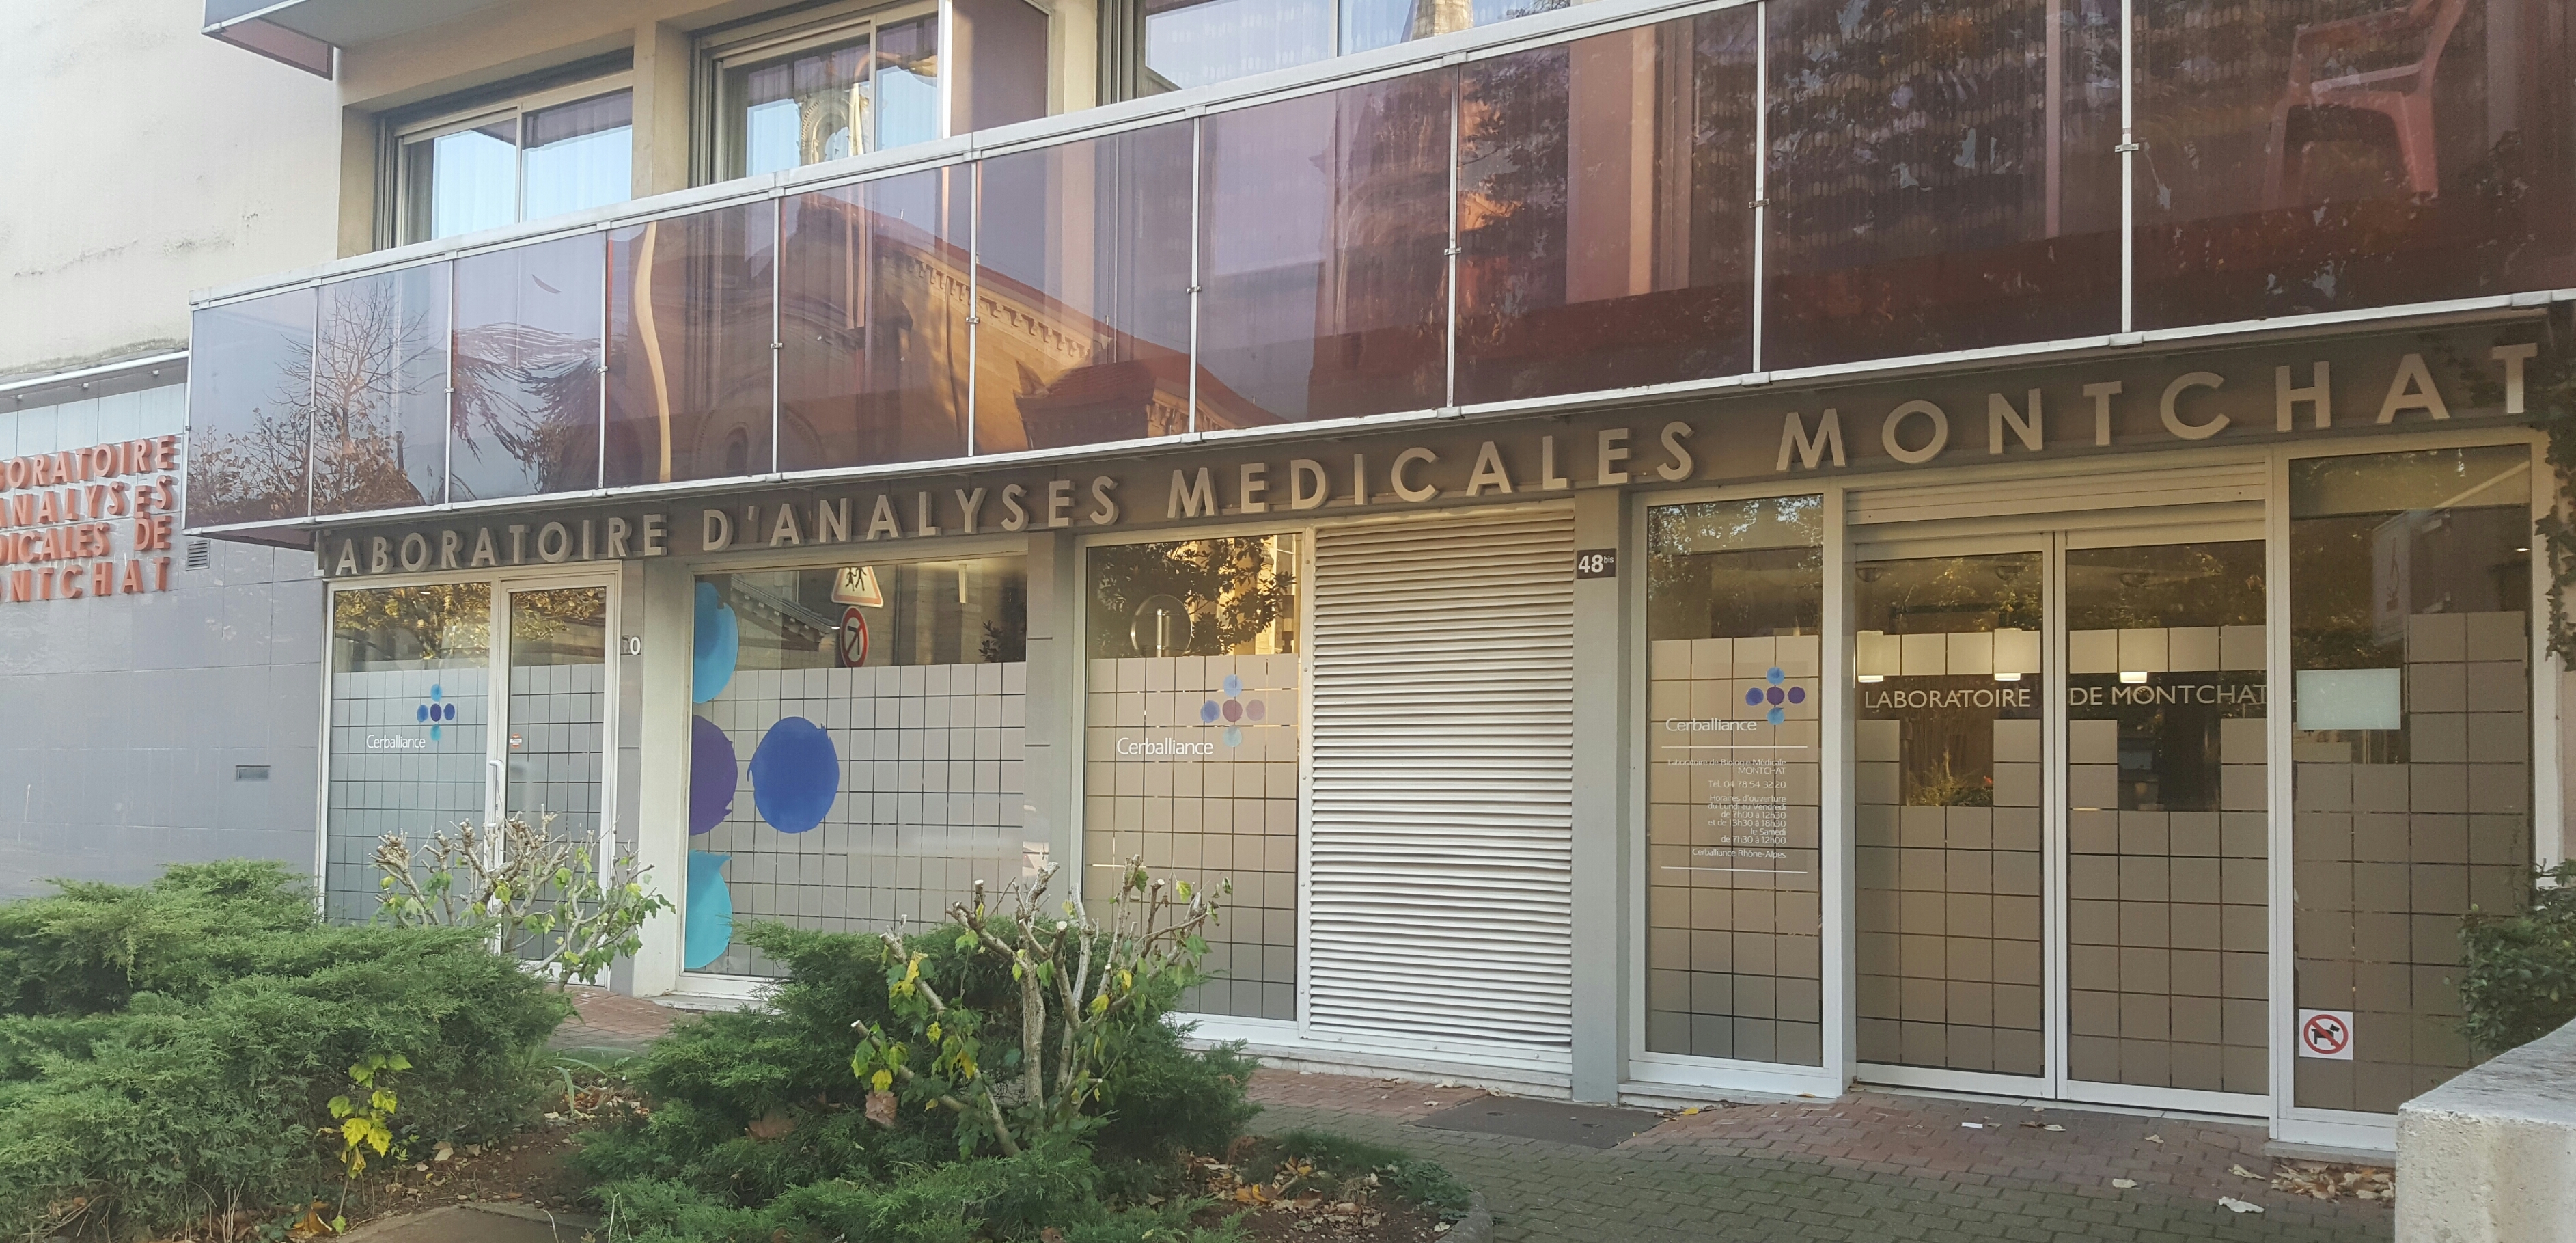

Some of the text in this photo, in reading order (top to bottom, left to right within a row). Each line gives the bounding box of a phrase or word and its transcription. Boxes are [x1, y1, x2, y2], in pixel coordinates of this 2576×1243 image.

[314, 342, 2538, 577] LABORATOIRE D'ANALYSES MEDICALES MONTCHAT
[134, 515, 171, 551] DE
[0, 556, 170, 602] NTCHAT
[1865, 683, 2267, 709] LABORATOIRE DE MONTCHAT
[1665, 718, 1758, 732] Cerballiance
[366, 734, 426, 749] Cerballiance
[1116, 737, 1214, 755] Cerballiance
[1720, 759, 1751, 767] Biologie
[1753, 803, 1786, 811] Vendredi
[1762, 811, 1786, 819] 12h30
[1762, 819, 1786, 828] 18h30
[1762, 836, 1786, 845] 12h00
[1692, 849, 1786, 859] Cerballiance Rhône-Alpes
